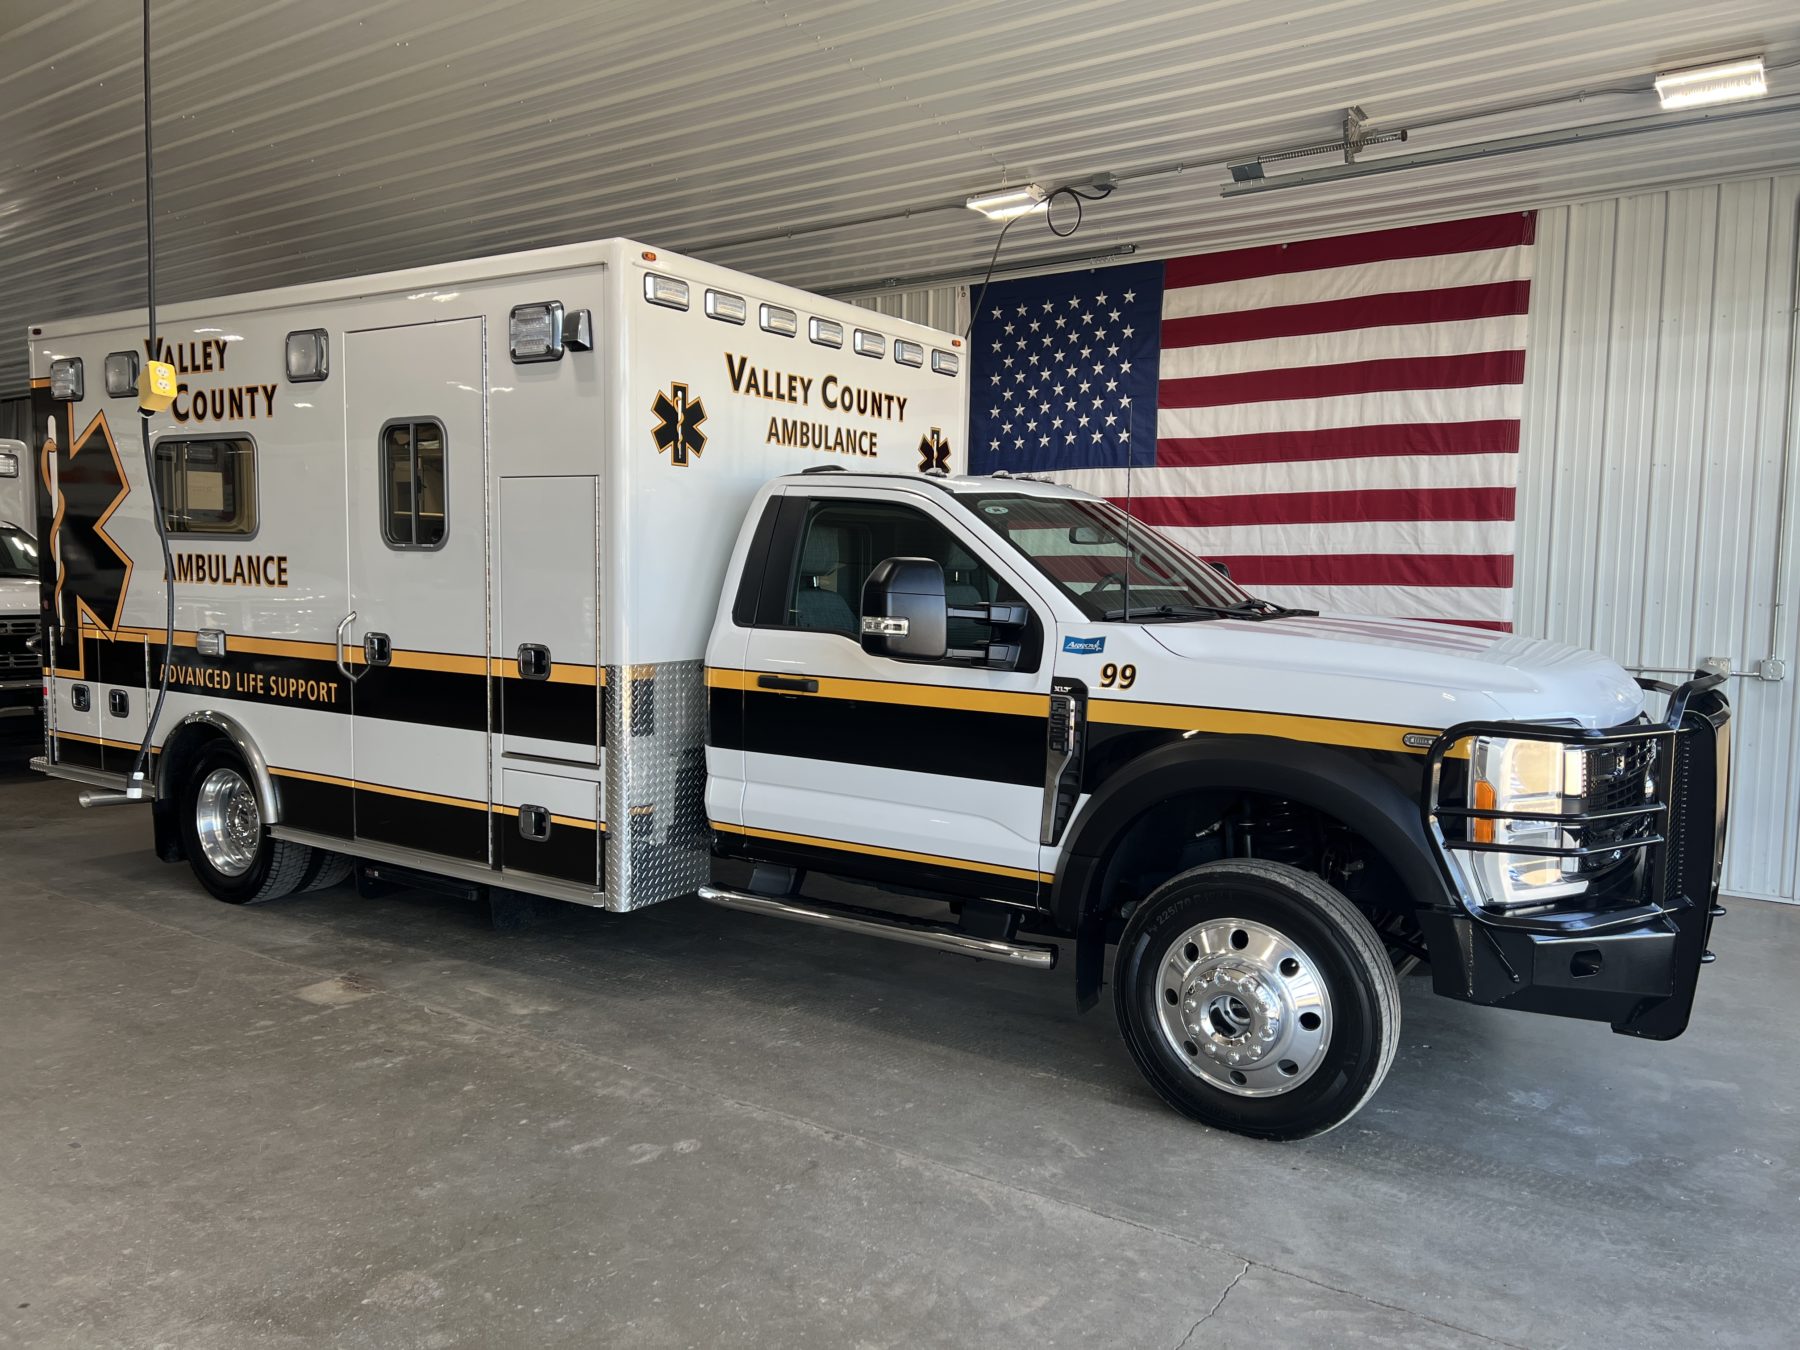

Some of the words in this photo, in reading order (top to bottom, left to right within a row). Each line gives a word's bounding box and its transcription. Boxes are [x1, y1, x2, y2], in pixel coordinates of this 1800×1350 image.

[172, 383, 278, 423] COUNTY
[724, 352, 813, 405] VALLEY
[820, 374, 908, 422] COUNTY
[765, 416, 878, 457] AMBULANCE
[164, 553, 287, 587] AMBULANCE
[236, 672, 265, 694] LIFE
[269, 676, 338, 704] SUPPORT
[1053, 685, 1073, 693] XLT
[1100, 662, 1137, 691] 99
